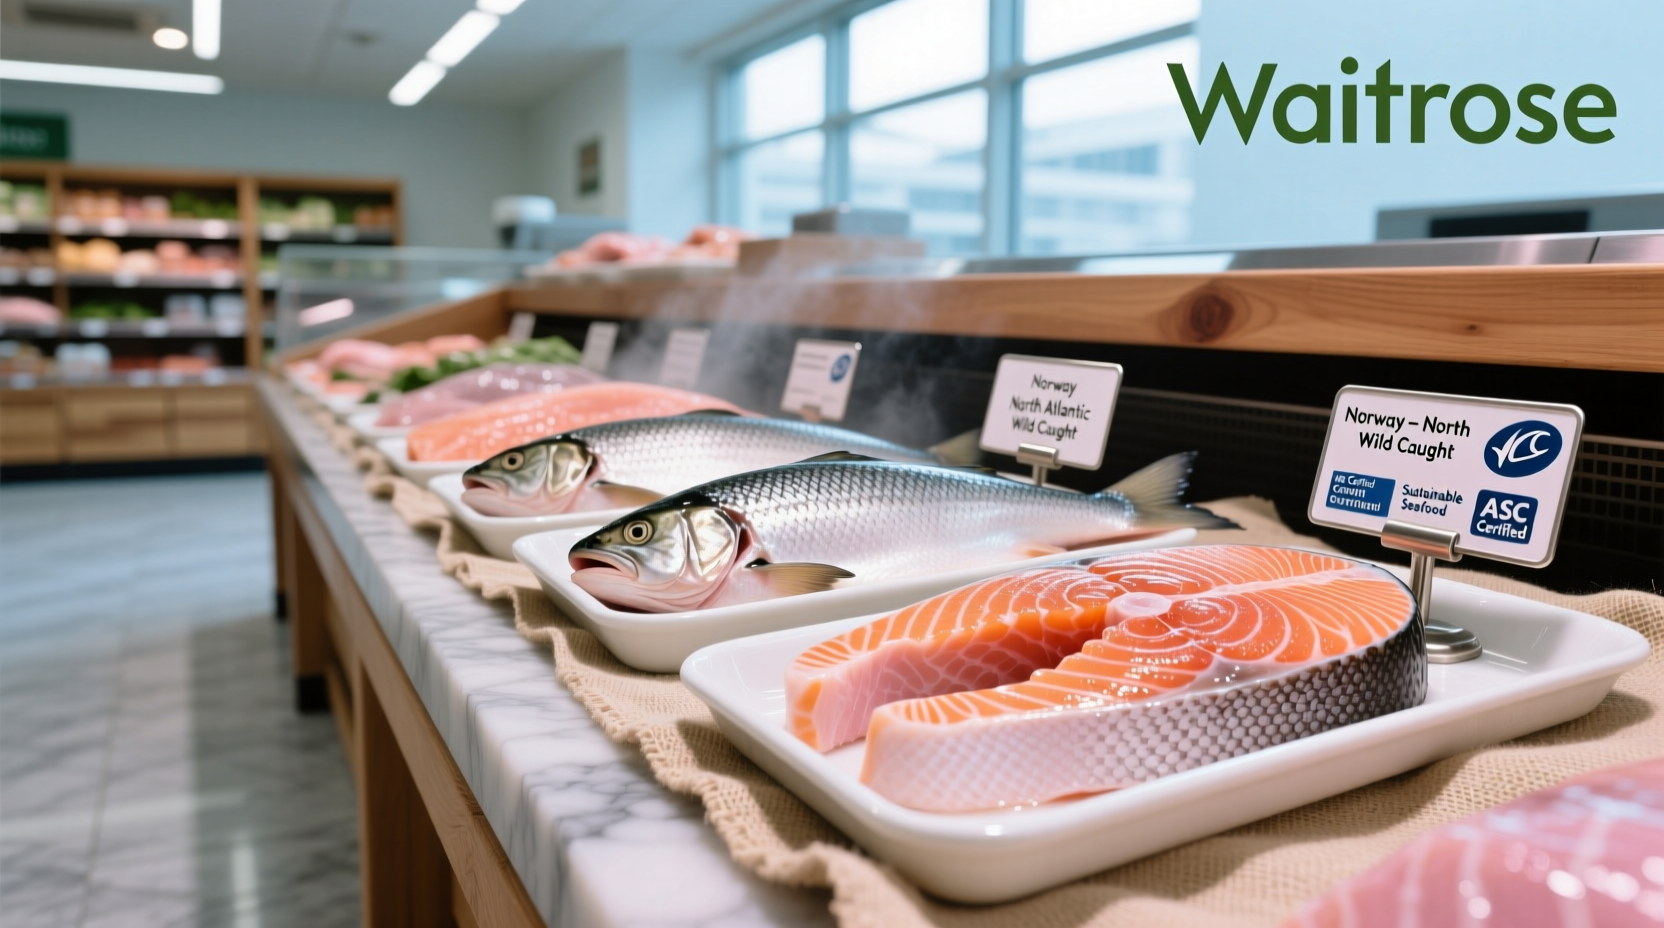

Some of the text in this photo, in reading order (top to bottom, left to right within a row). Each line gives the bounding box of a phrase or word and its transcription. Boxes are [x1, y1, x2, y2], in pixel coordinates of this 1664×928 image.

[1031, 373, 1077, 398] Norway
[1009, 395, 1091, 421] North Atlantic
[1012, 416, 1078, 441] Wild Caught
[1345, 406, 1406, 433] Norway
[1423, 415, 1471, 438] North
[1359, 431, 1455, 462] Wild Caught
[1401, 498, 1448, 517] Seafood
[1479, 497, 1530, 524] ASC
